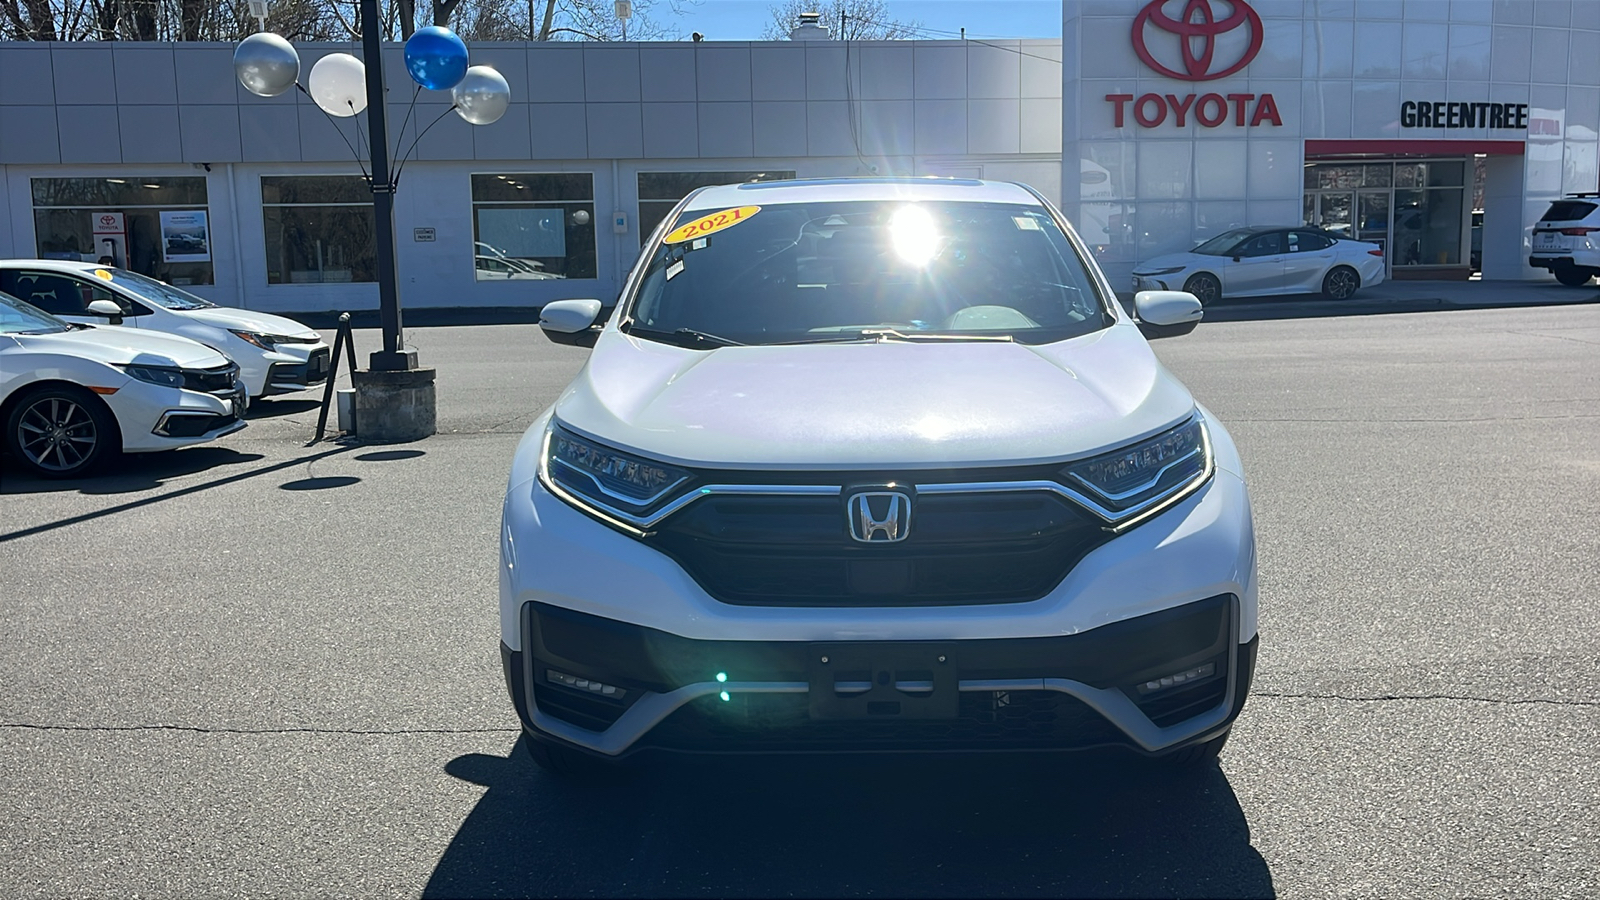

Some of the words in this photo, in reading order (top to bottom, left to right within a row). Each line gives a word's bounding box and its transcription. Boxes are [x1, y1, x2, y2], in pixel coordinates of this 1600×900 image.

[1105, 93, 1283, 128] TOYOTA
[1400, 101, 1528, 129] GREENTREE
[682, 209, 744, 239] 2021
